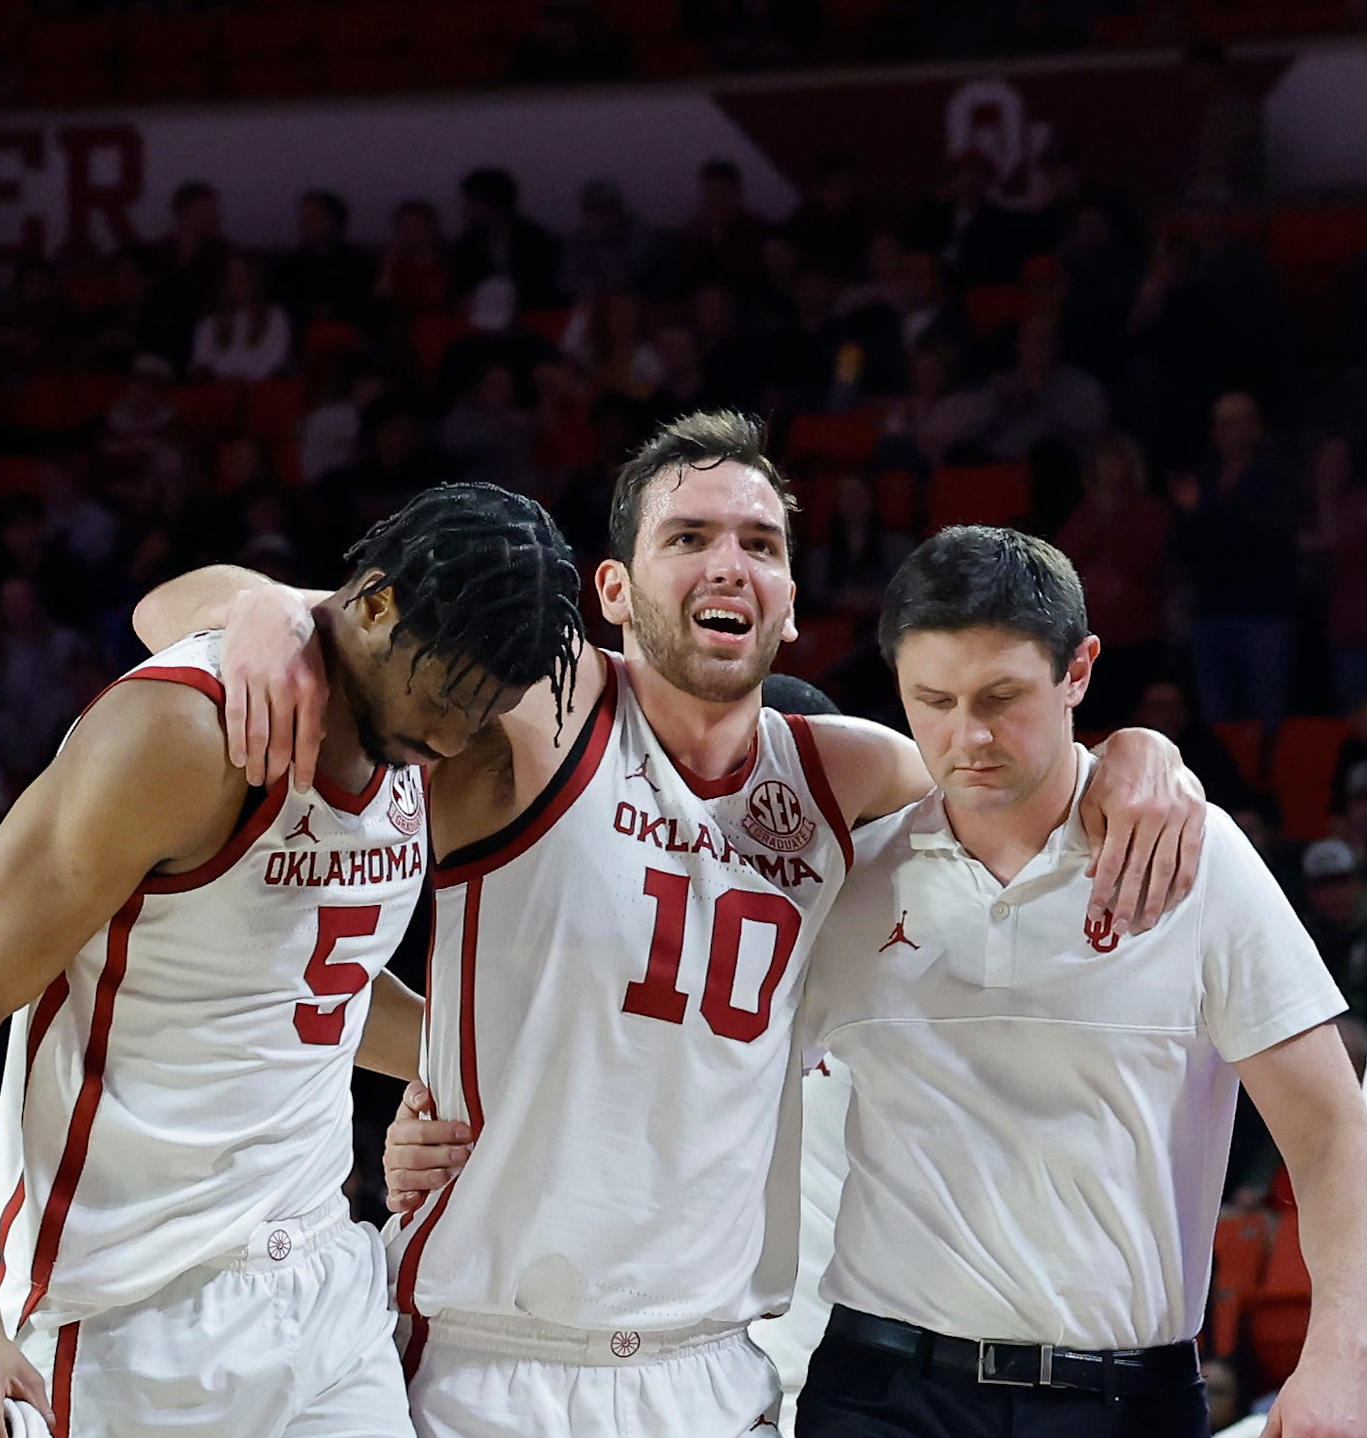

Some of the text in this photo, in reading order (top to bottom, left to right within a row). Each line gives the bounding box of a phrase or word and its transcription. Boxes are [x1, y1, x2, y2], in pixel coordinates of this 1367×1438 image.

[613, 801, 824, 887] OKLAHMA
[750, 782, 801, 834] SEC
[264, 842, 422, 887] OKLAHOMA
[293, 904, 382, 1046] 5
[622, 866, 802, 1044] 10
